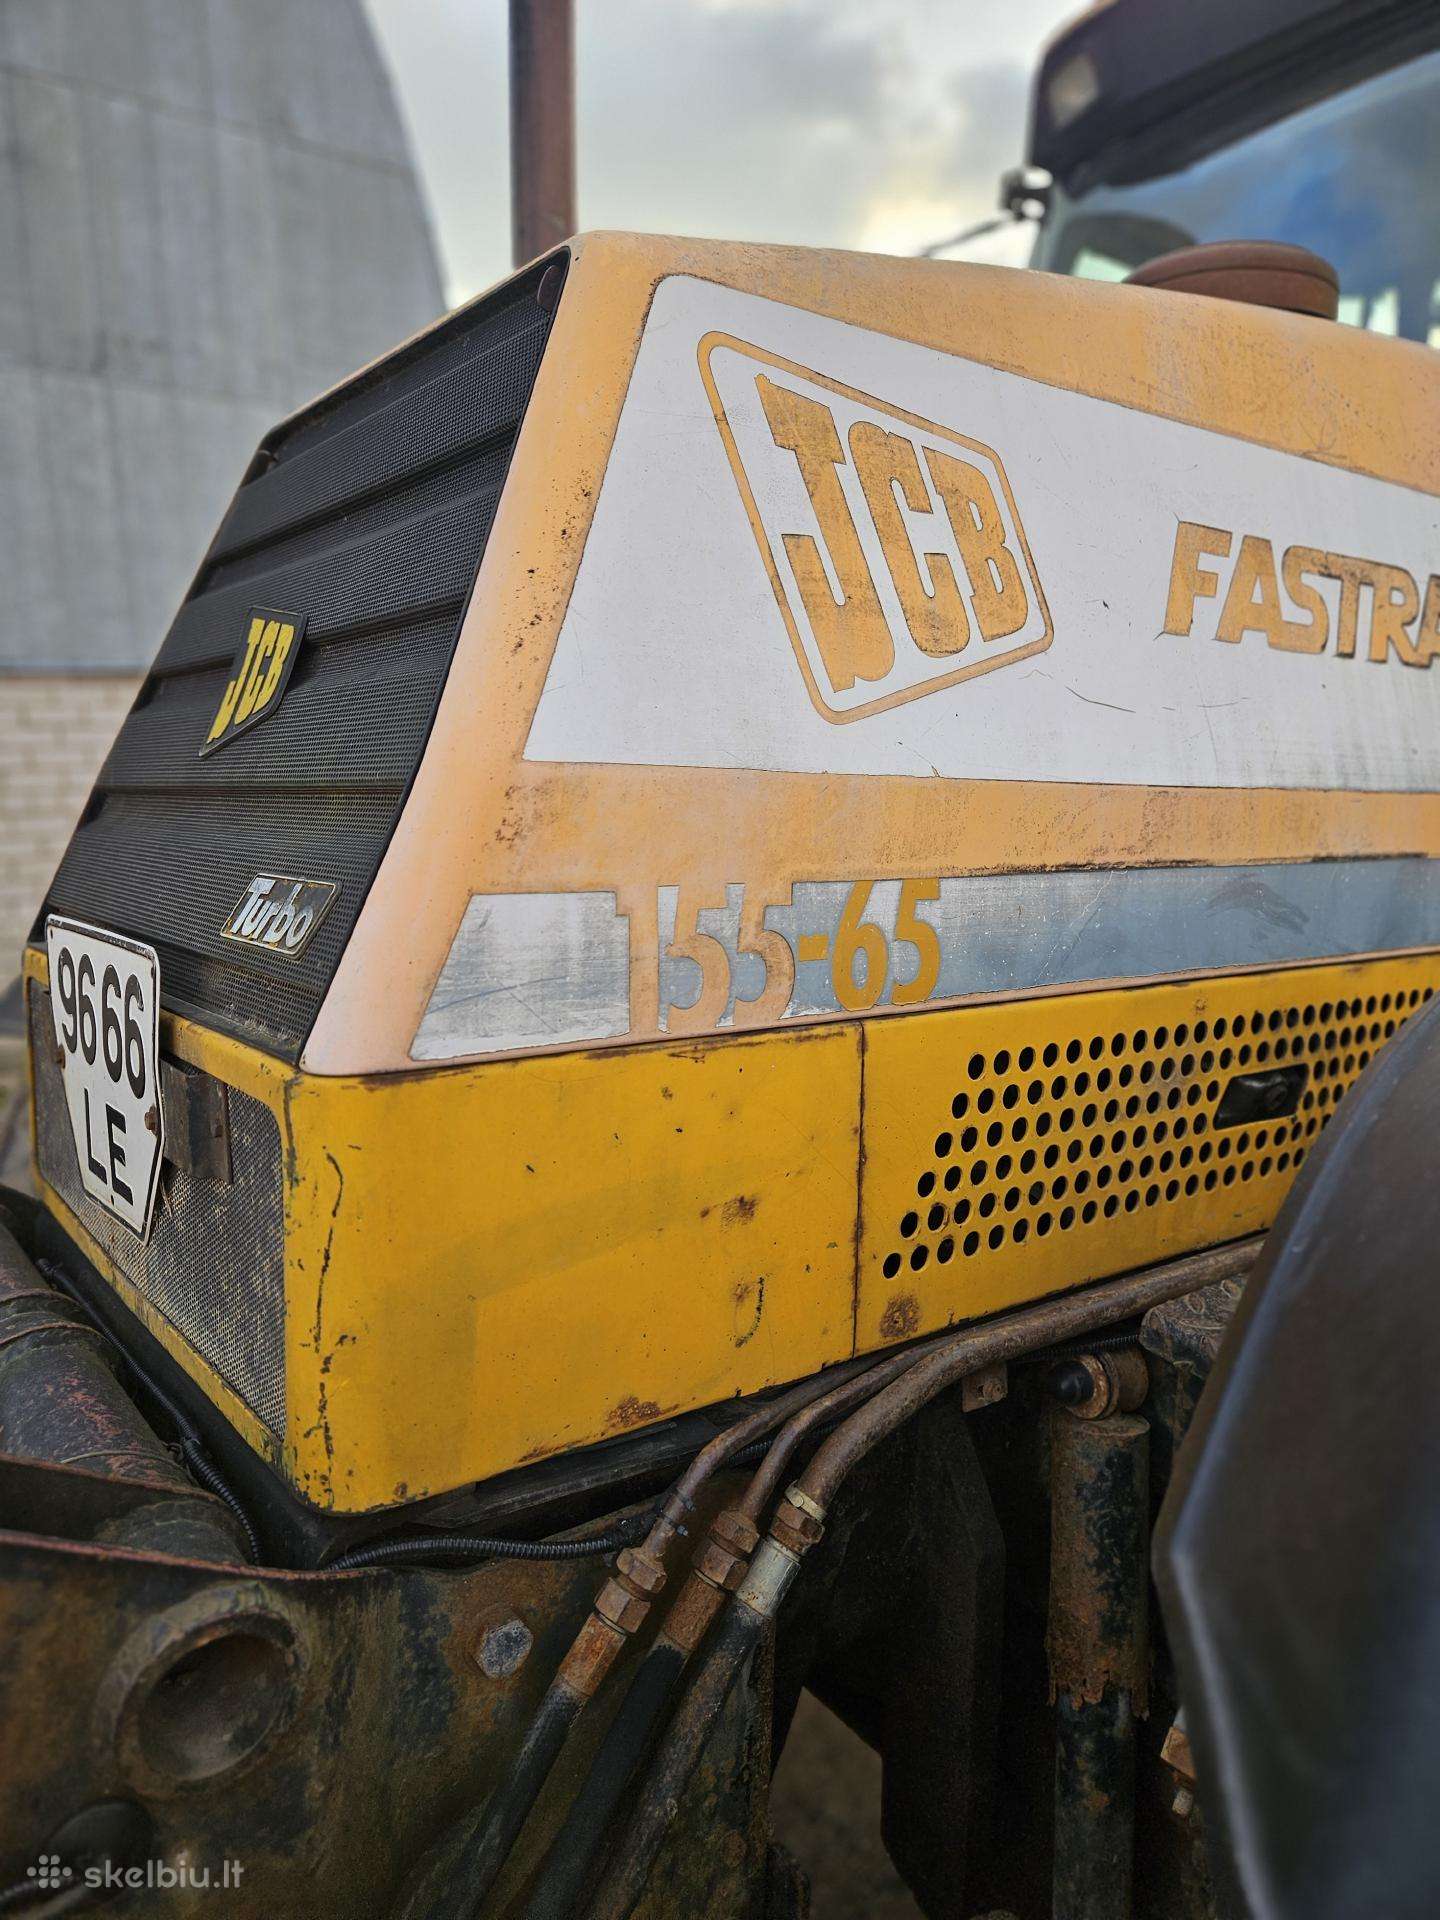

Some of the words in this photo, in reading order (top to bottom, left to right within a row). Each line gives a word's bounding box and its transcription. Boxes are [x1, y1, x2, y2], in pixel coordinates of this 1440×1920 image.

[755, 374, 1029, 692] JCB
[205, 617, 295, 744] JCB
[230, 876, 314, 948] Turbo
[615, 877, 942, 1034] 155-65
[83, 1087, 134, 1207] LE
